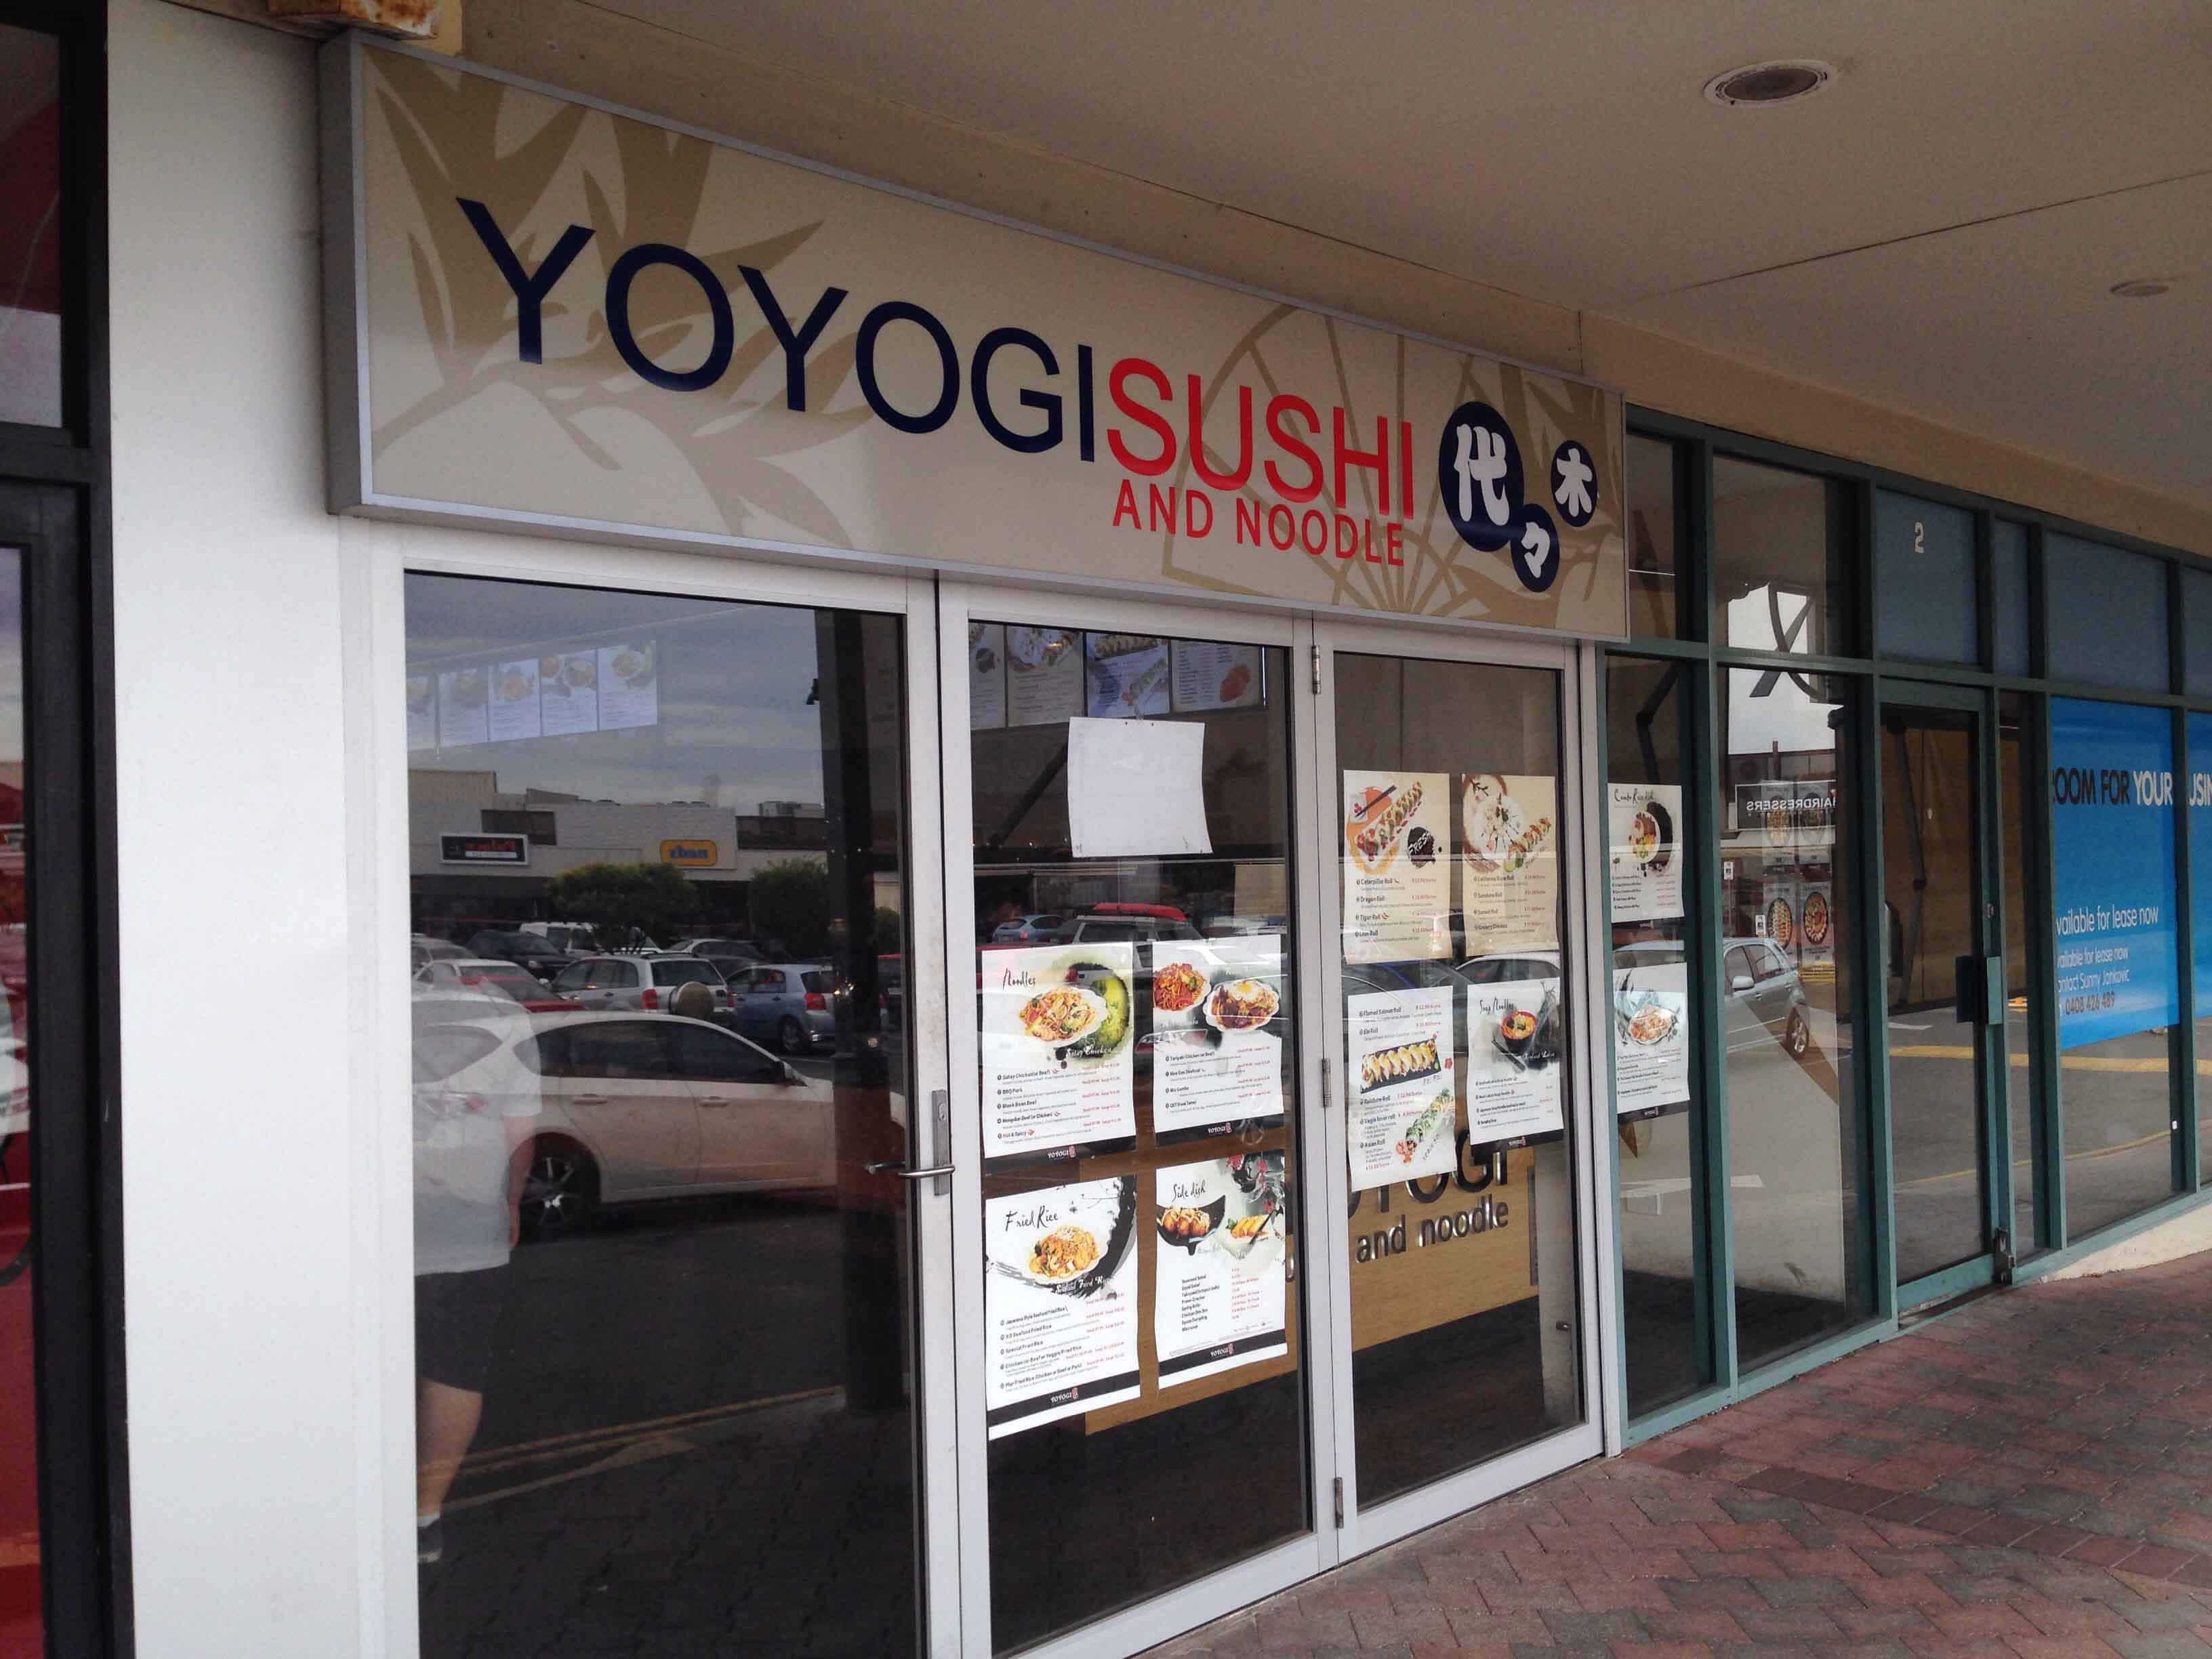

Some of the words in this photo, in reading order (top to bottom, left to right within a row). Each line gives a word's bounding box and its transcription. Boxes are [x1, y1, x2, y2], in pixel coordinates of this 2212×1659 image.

[456, 197, 1095, 462] YOYOGI
[1107, 357, 1414, 520] SUSHI
[1112, 478, 1213, 538] AND
[1237, 497, 1405, 567] NOODLE
[1914, 521, 1925, 554] 2
[2053, 766, 2096, 805] OOM
[2101, 769, 2130, 805] FOR
[2133, 770, 2173, 806] YOUR
[2097, 905, 2110, 931] for
[2111, 904, 2137, 928] lease
[2139, 907, 2158, 926] now
[2085, 946, 2094, 965] for
[2095, 945, 2113, 964] lease
[2114, 947, 2129, 960] now
[2080, 972, 2100, 990] Sunny
[1005, 1207, 1035, 1231] Fried
[1036, 1205, 1059, 1228] Rice
[1356, 1214, 1406, 1263] and
[1417, 1193, 1509, 1248] noodle
